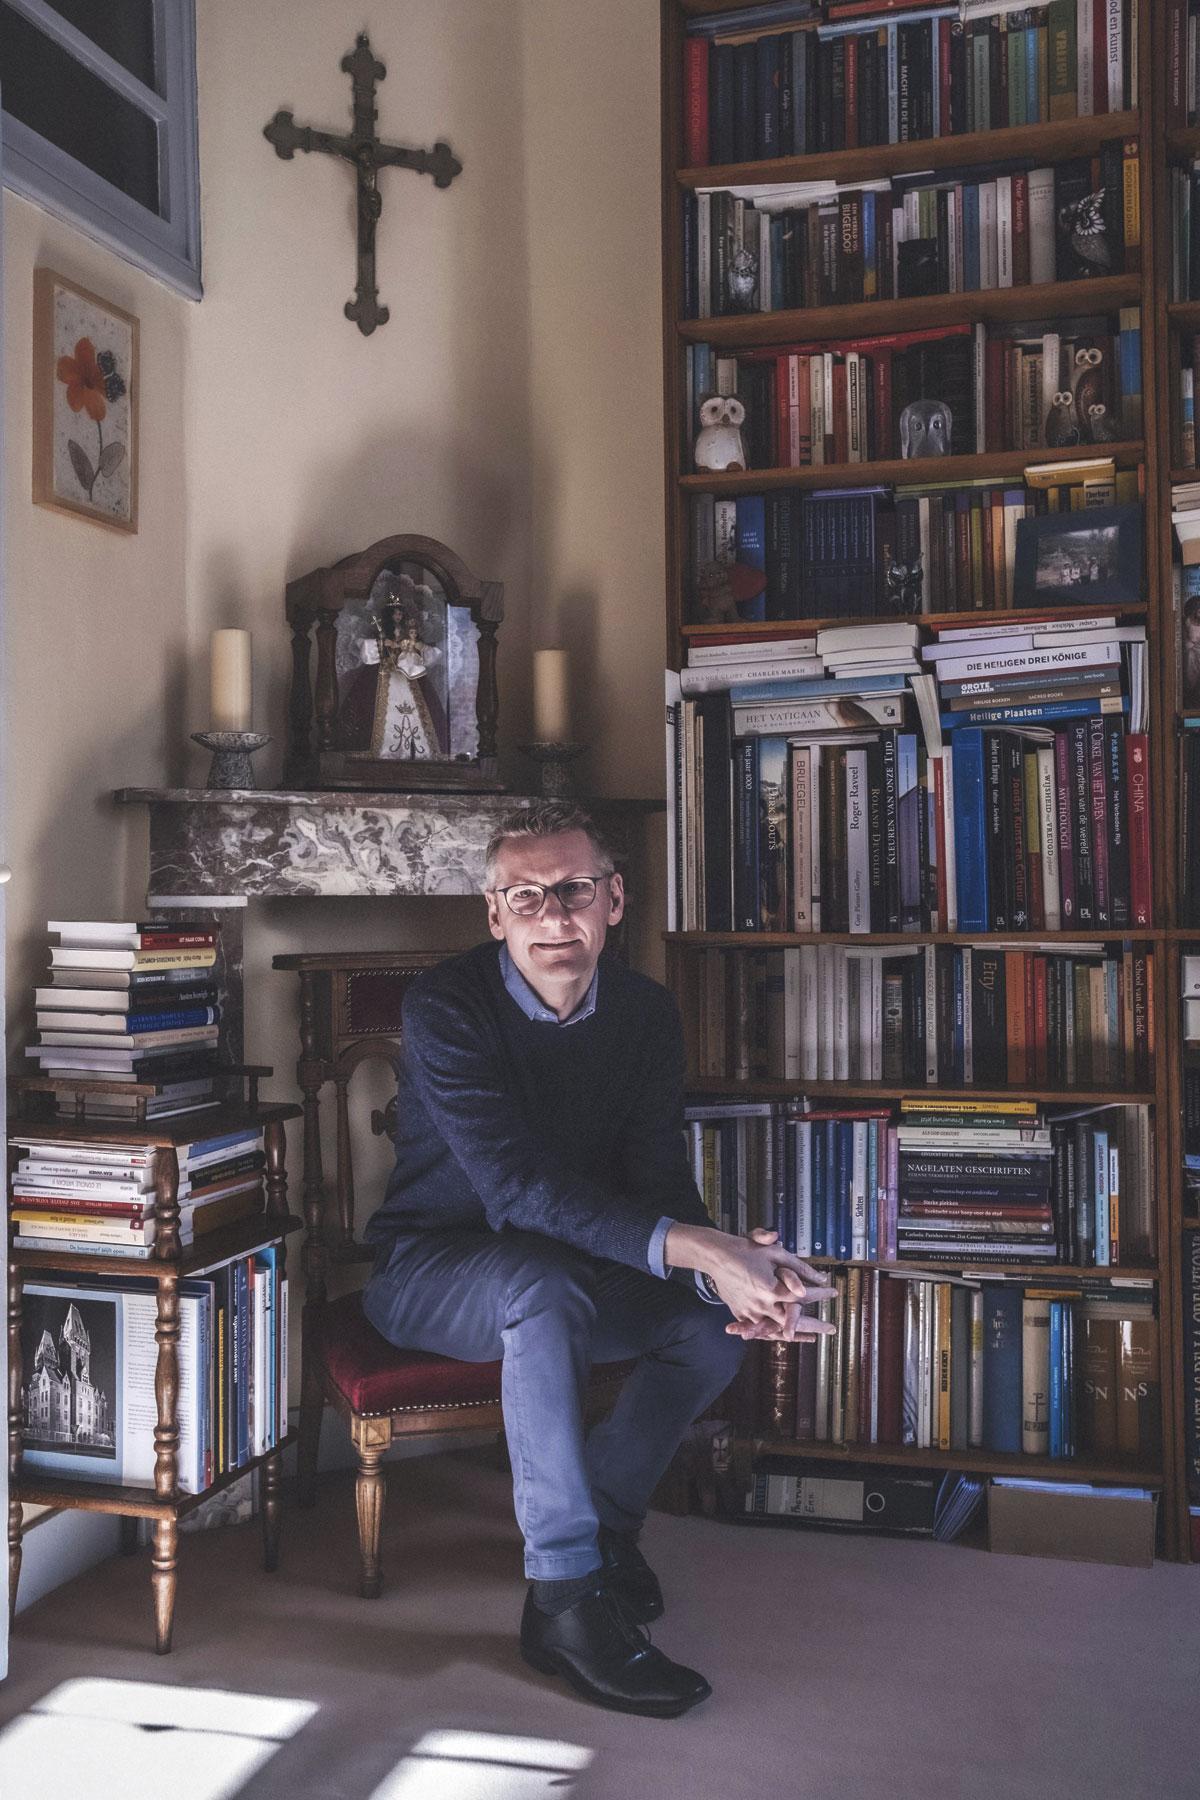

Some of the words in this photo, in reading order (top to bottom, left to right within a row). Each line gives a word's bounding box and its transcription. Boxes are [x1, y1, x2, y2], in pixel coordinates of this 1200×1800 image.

[1109, 0, 1120, 15] od
[1109, 17, 1118, 31] en
[1109, 32, 1120, 63] kunst
[900, 65, 908, 97] MACHT
[900, 98, 908, 108] IN
[900, 110, 908, 122] DE
[1015, 179, 1024, 200] Peter
[1125, 164, 1133, 205] WOORDEN
[842, 204, 851, 254] BIJGELOOF
[1052, 622, 1075, 630] Melchior
[1079, 619, 1098, 628] Caspar
[966, 662, 982, 671] DIE
[983, 658, 1026, 669] HEILIGEN
[1028, 655, 1050, 665] DREI
[1052, 651, 1087, 662] KÖNIGE
[747, 669, 780, 678] CHARLES
[782, 667, 806, 675] MARSH
[961, 681, 991, 690] GROTE
[746, 711, 767, 723] HET
[769, 709, 822, 721] VATICAAN
[970, 710, 1002, 721] Heilige
[1004, 707, 1043, 718] Plaatsen
[1076, 727, 1085, 740] De
[744, 745, 752, 757] Het
[883, 741, 894, 763] TIJD
[1074, 741, 1084, 763] grote
[743, 758, 752, 772] jaar
[1092, 761, 1103, 777] VAN
[796, 760, 806, 811] BRUEGEL
[849, 766, 860, 798] Raveel
[886, 767, 894, 793] ONZE
[1075, 764, 1086, 795] mythen
[1092, 779, 1103, 793] HET
[1042, 774, 1052, 813] WIJSHEID
[1113, 790, 1121, 802] Het
[1131, 773, 1144, 814] CHINA
[849, 801, 862, 830] Roger
[871, 788, 881, 828] ROLAND
[886, 796, 894, 816] VAN
[1078, 797, 1086, 813] van
[1058, 787, 1068, 851] MYTHOLOGIE
[1079, 814, 1088, 825] de
[1113, 803, 1121, 832] Verboden
[768, 817, 779, 851] BOUTS
[1014, 816, 1022, 844] Kunst
[1045, 822, 1054, 856] VREUGD
[1079, 827, 1089, 854] wereld
[1113, 833, 1122, 845] Rijk
[887, 819, 896, 865] KLEUREN
[872, 833, 881, 886] DEVOLDER
[1015, 863, 1024, 903] Cultuur
[978, 959, 998, 991] Etty
[1135, 959, 1143, 986] School
[1135, 1003, 1143, 1014] de
[1135, 1015, 1144, 1038] liefde
[906, 1163, 963, 1173] NAGELATEN
[965, 1165, 1032, 1176] GESCHRIFTEN
[1096, 1173, 1104, 1195] MISSION
[855, 1195, 864, 1218] Sichten
[929, 1254, 962, 1262] PATHWAYS
